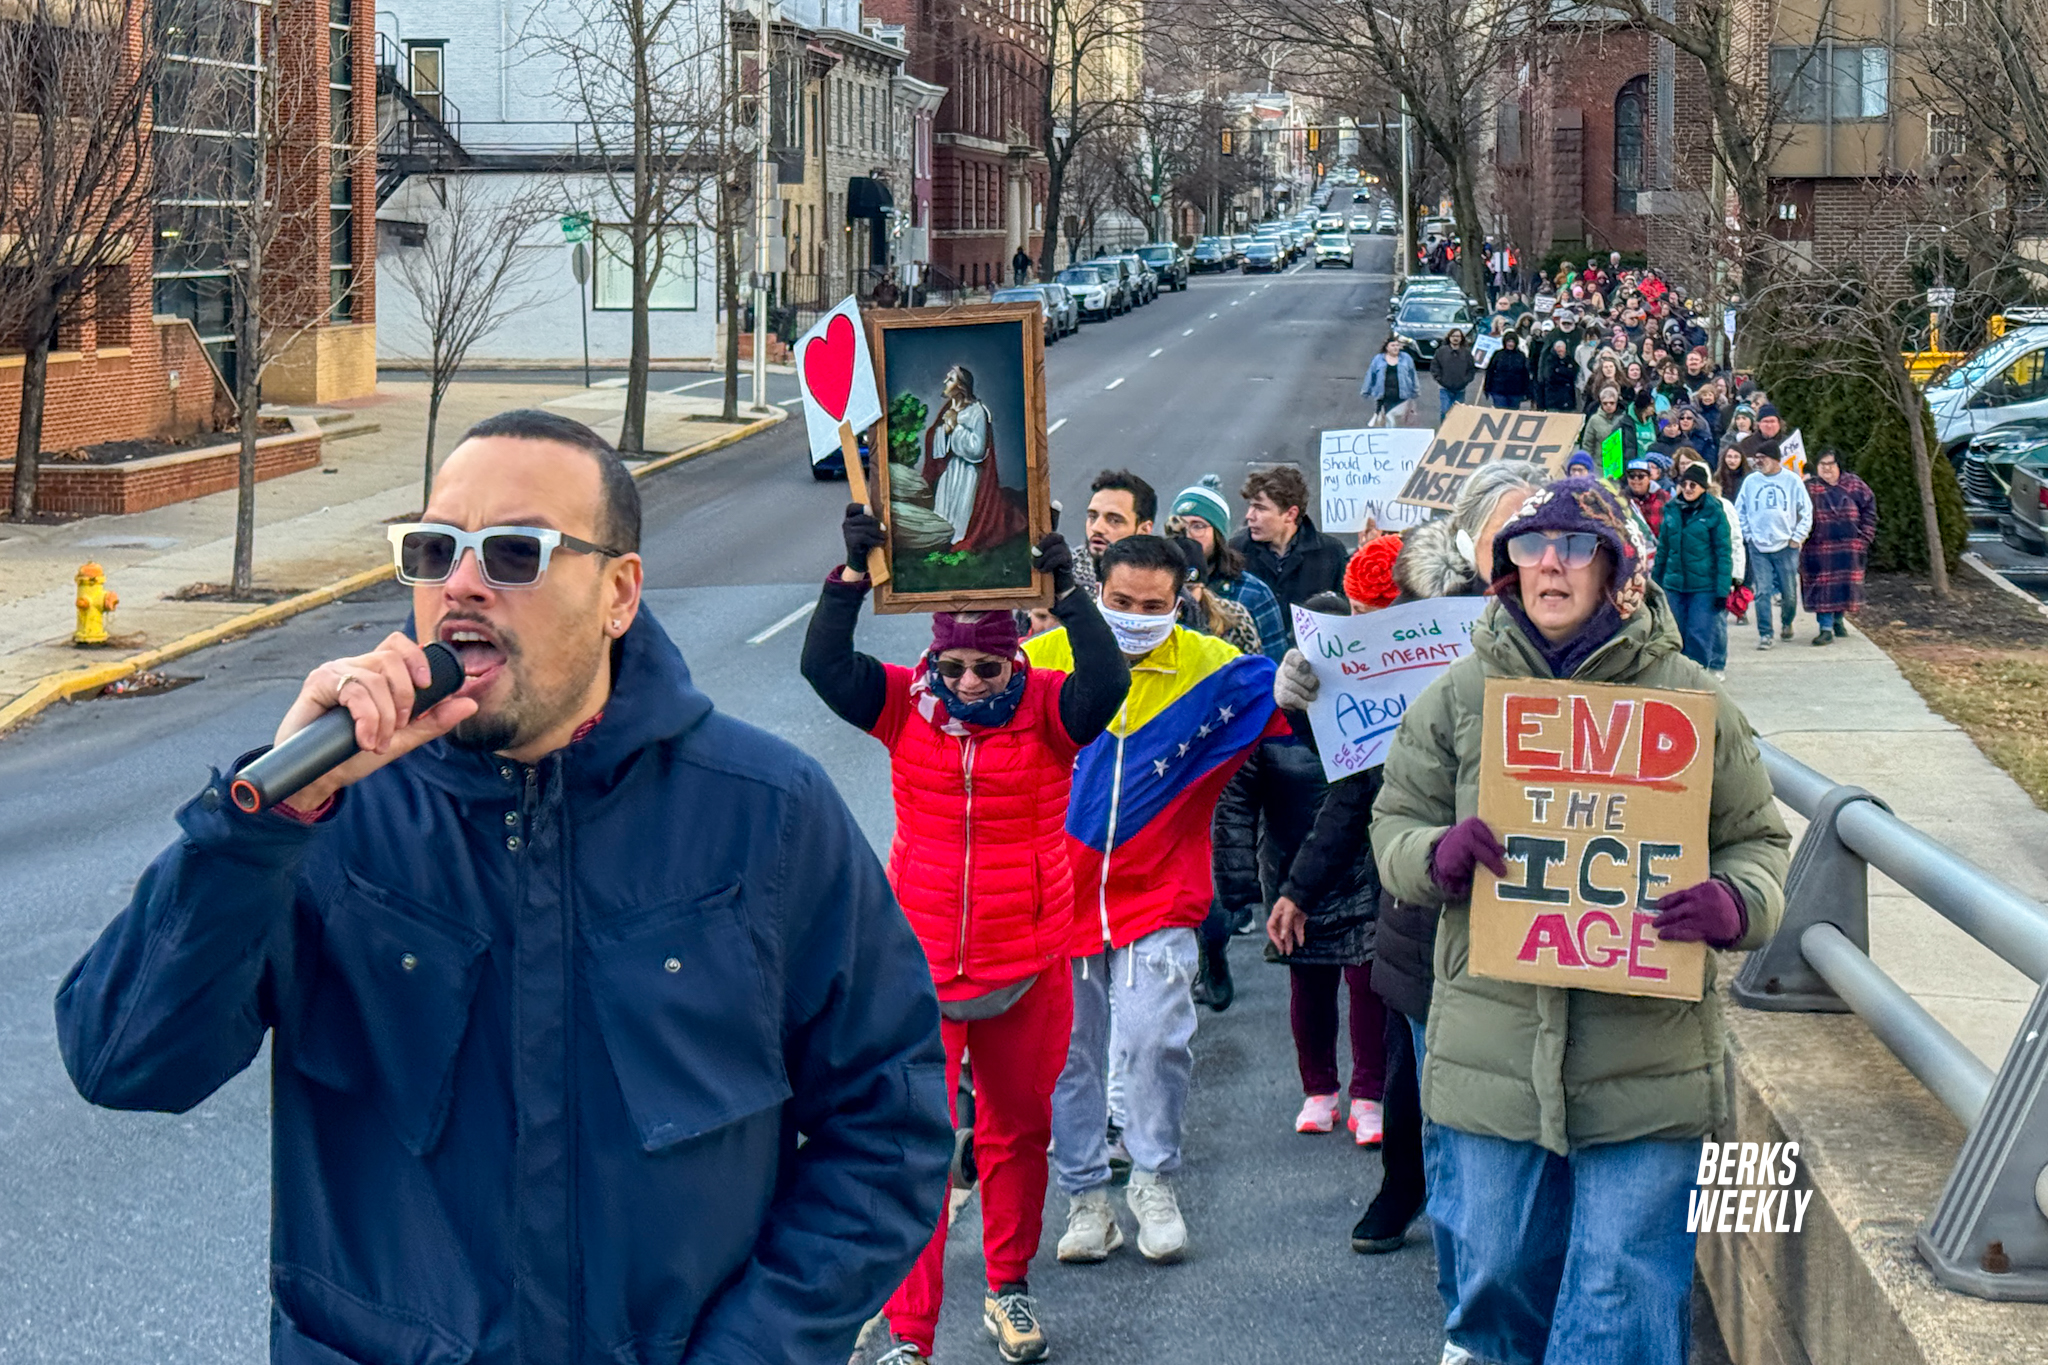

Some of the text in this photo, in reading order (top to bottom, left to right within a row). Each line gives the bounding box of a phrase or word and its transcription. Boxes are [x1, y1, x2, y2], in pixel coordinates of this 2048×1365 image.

[1469, 413, 1548, 443] NO
[1325, 434, 1389, 455] ICE
[1374, 457, 1394, 471] be
[1401, 457, 1414, 471] in
[1324, 473, 1340, 491] my
[1326, 498, 1358, 523] NOT
[1364, 499, 1383, 520] MY
[1317, 632, 1366, 659] We
[1392, 619, 1442, 642] said
[1341, 643, 1462, 676] We MEANT
[1504, 692, 1700, 782] END
[1332, 743, 1351, 767] ICE
[1345, 744, 1367, 770] OUT
[1524, 786, 1628, 832] THE
[1495, 834, 1683, 914] ICE
[1516, 909, 1670, 982] AGE
